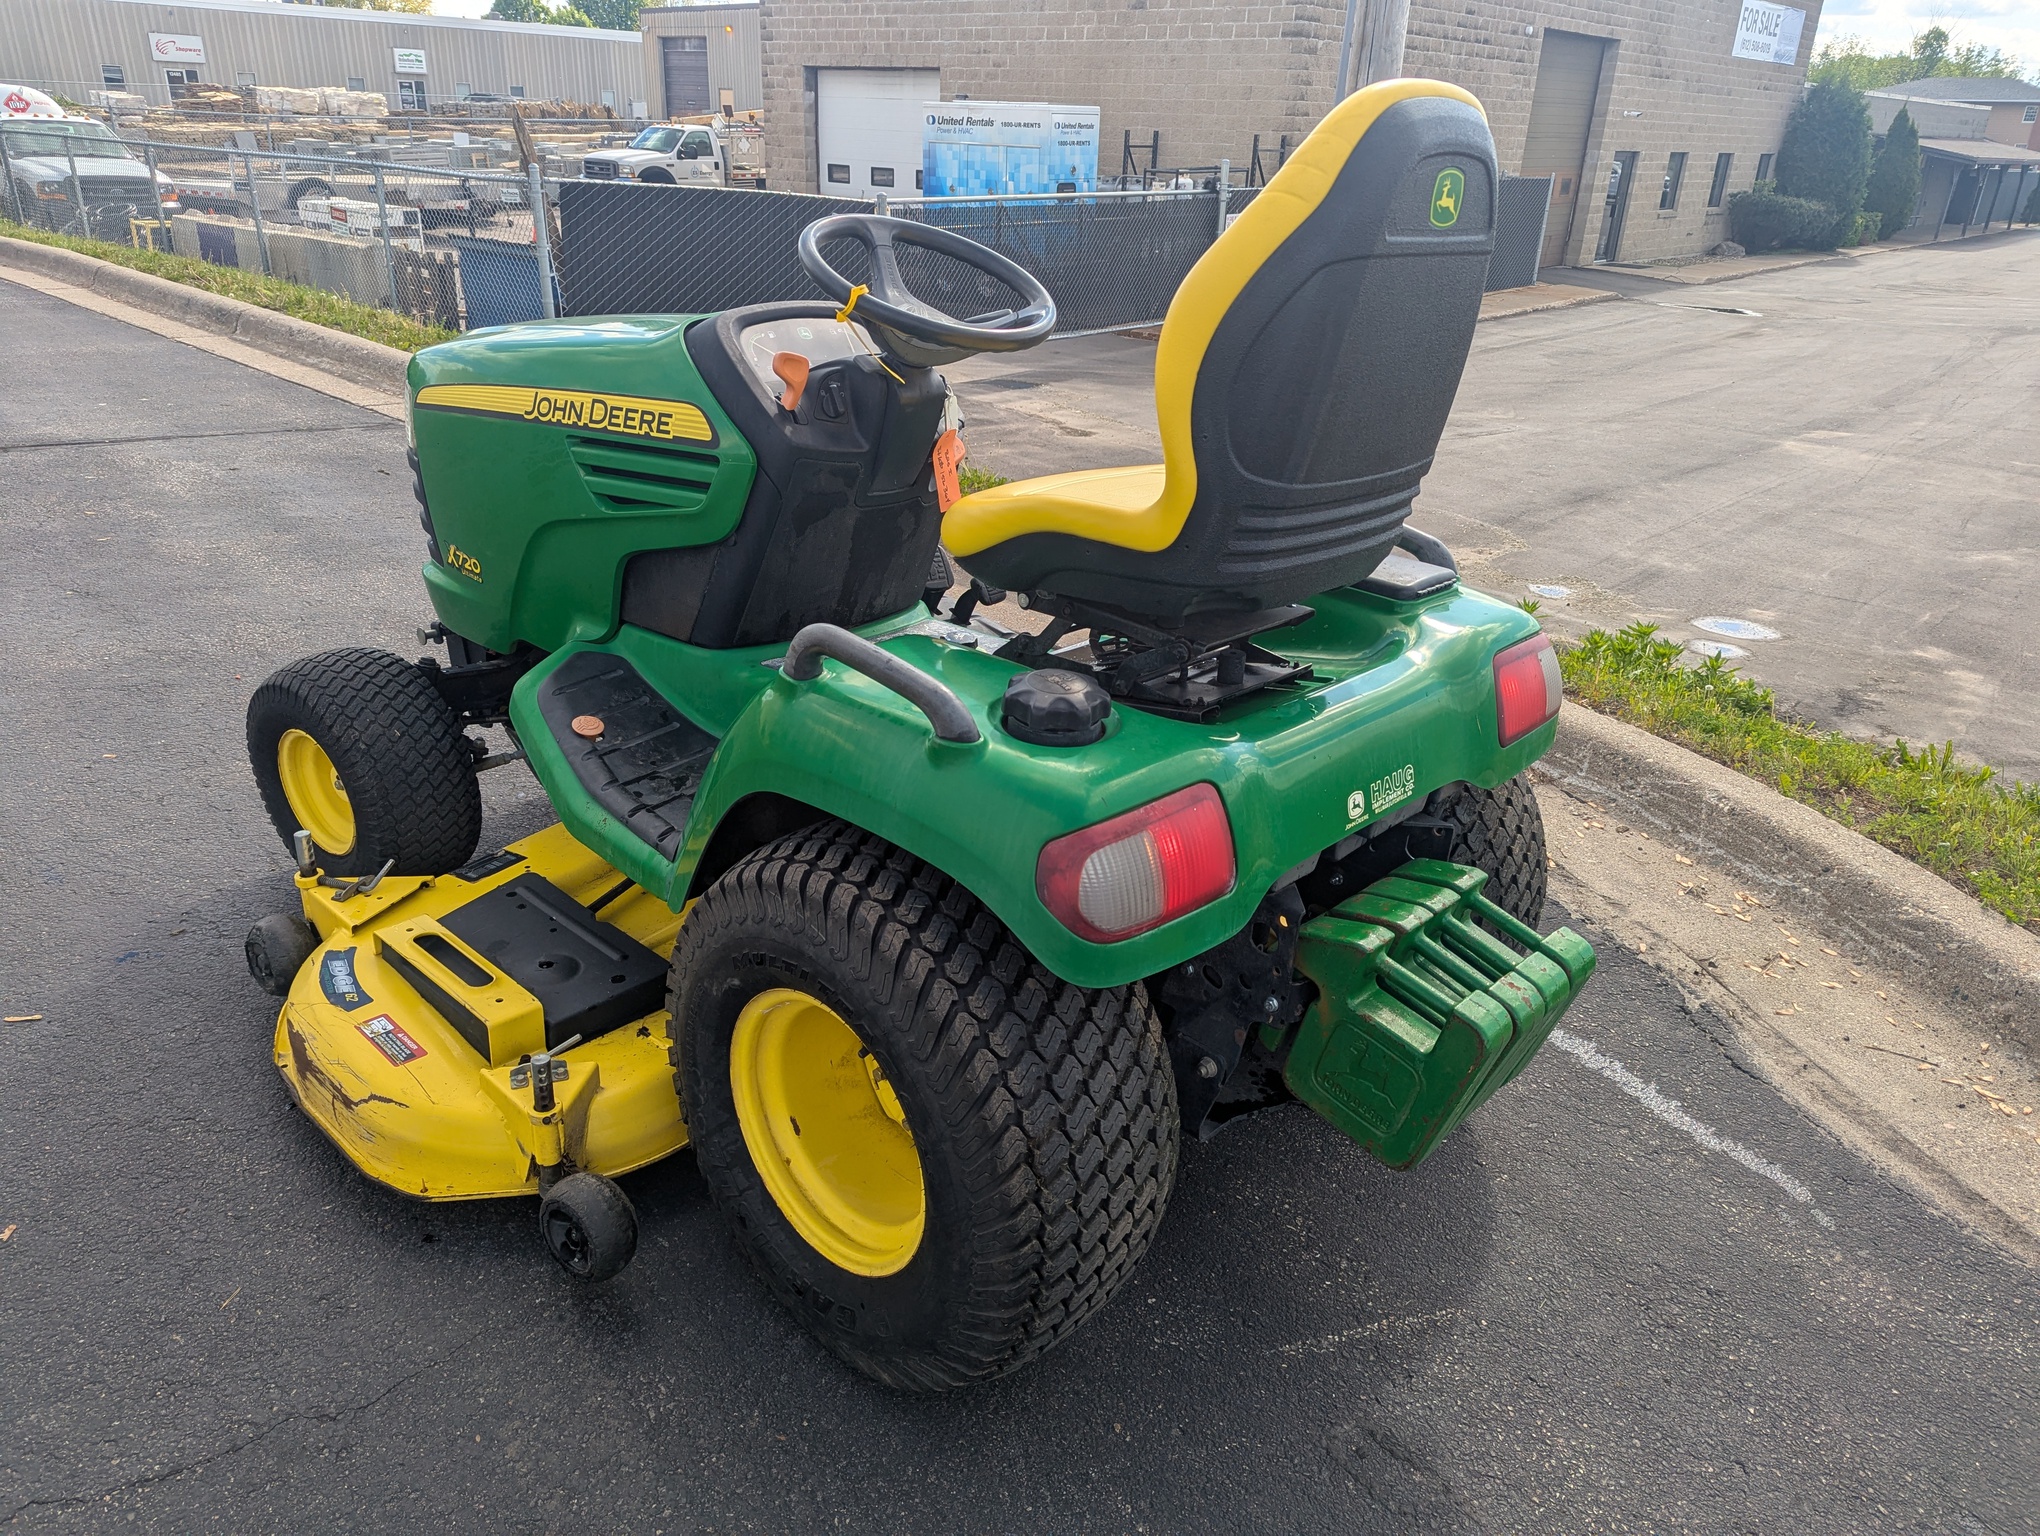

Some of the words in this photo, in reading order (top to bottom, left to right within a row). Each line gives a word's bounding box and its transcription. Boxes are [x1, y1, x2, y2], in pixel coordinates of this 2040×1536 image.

[1740, 7, 1760, 33] FOR
[1758, 10, 1781, 37] SALE
[10, 101, 26, 109] 1075
[937, 115, 964, 127] United
[965, 116, 995, 127] Rentals
[1001, 121, 1041, 129] 1800-UR-RENTS
[957, 127, 974, 135] HVAC
[1061, 122, 1077, 130] United
[1077, 122, 1095, 130] Rentals
[524, 391, 586, 424] JOHN
[589, 398, 673, 437] DEERE
[447, 544, 482, 574] X720
[1370, 764, 1415, 804] HAUG
[1372, 789, 1405, 810] IMPLEMENT
[327, 958, 356, 994] EDGE
[731, 951, 810, 983] MULTI
[401, 1034, 418, 1050] DANGER
